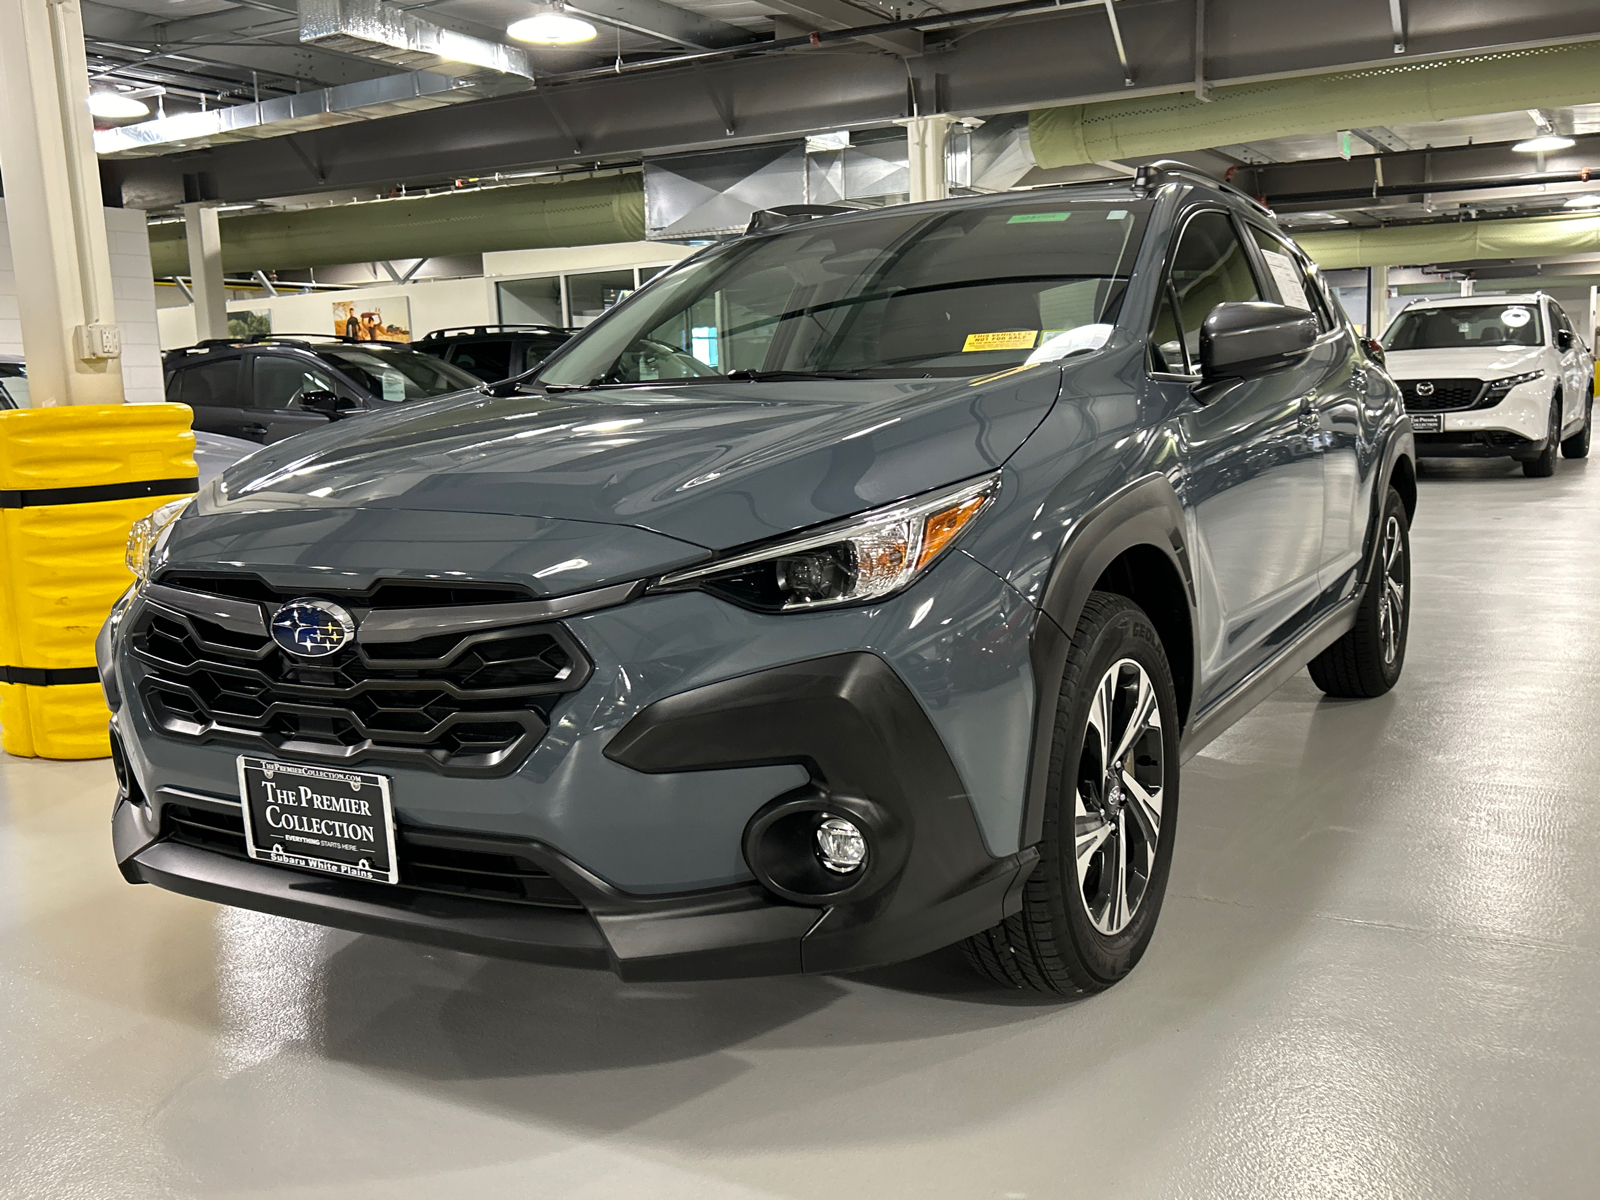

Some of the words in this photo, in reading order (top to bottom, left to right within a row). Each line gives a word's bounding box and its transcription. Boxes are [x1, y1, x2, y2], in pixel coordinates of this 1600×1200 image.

[285, 834, 320, 846] EVERYTHING
[320, 839, 341, 849] STARTS
[270, 852, 306, 866] Subaru
[307, 858, 338, 873] White
[341, 864, 373, 880] Plains
